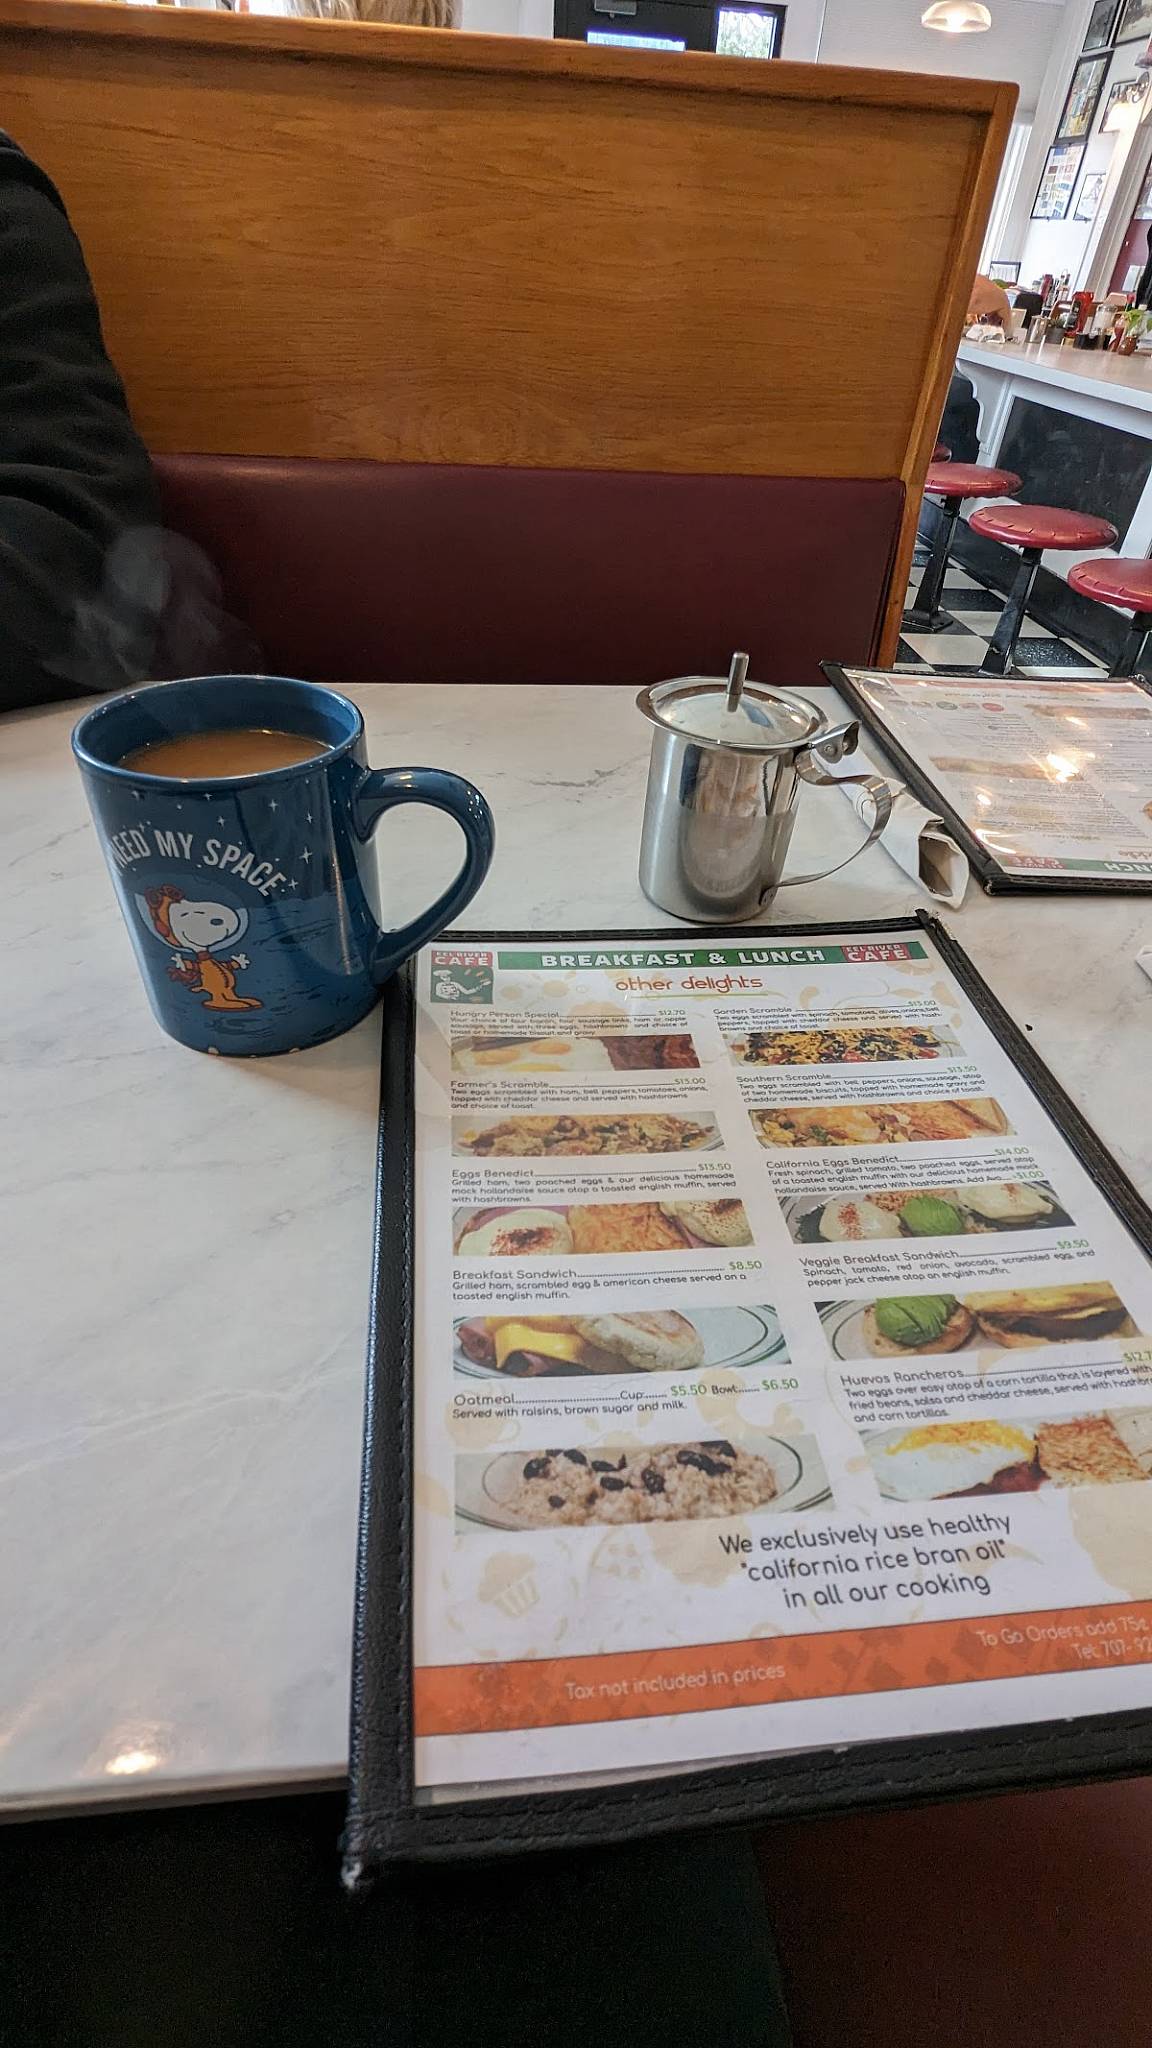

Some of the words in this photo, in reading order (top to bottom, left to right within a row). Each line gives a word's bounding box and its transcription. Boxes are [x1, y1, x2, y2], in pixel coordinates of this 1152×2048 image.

[111, 829, 151, 868] NEED
[153, 830, 193, 860] MY
[203, 839, 287, 897] SPACE
[434, 956, 489, 966] CAFE
[542, 953, 695, 967] BREAKFAST
[708, 952, 727, 964] &
[739, 950, 825, 964] LUNCH
[847, 949, 907, 961] CAFE
[616, 976, 673, 991] other
[681, 974, 764, 994] delights
[451, 1010, 487, 1018] Hungry
[525, 1011, 559, 1019] Special
[749, 1005, 792, 1013] Scramble
[451, 1080, 497, 1088] Farmer's
[501, 1079, 549, 1087] Scramble
[785, 1072, 831, 1080] Scramble
[766, 1159, 820, 1168] California
[822, 1158, 849, 1167] Eggs
[851, 1155, 899, 1164] Benedict
[768, 1169, 794, 1177] Fresh
[836, 1166, 863, 1176] grilled
[918, 1160, 956, 1171] poached
[984, 1157, 1012, 1165] served
[452, 1170, 481, 1179] Eggs
[484, 1168, 534, 1177] Benedict
[775, 1185, 827, 1194] hollandaise
[859, 1182, 886, 1190] served
[967, 1176, 984, 1184] Add
[799, 1257, 840, 1268] Veggie
[843, 1253, 899, 1264] Breakfast
[902, 1249, 959, 1261] Sandwich
[1057, 1239, 1089, 1250] $9.50
[453, 1269, 512, 1279] Breakfast
[517, 1267, 576, 1278] Sandwich
[729, 1261, 763, 1271] $8.50
[803, 1266, 845, 1278] Spinach,
[852, 1264, 889, 1273] tomato,
[896, 1262, 912, 1270] red
[1002, 1252, 1050, 1263] scrambled
[1077, 1248, 1095, 1257] and
[452, 1281, 485, 1290] Grilled
[489, 1281, 513, 1290] ham,
[517, 1279, 569, 1288] scrambled
[572, 1280, 591, 1289] egg
[603, 1277, 650, 1286] american
[653, 1275, 687, 1284] cheese
[690, 1273, 721, 1282] served
[808, 1278, 841, 1288] pepper
[844, 1275, 865, 1286] jack
[867, 1275, 900, 1283] cheese
[902, 1272, 926, 1282] atop
[942, 1269, 975, 1280] english
[453, 1291, 493, 1300] toasted
[496, 1290, 533, 1301] english
[536, 1290, 570, 1298] muffin.
[840, 1375, 890, 1385] Huevos
[895, 1369, 964, 1381] Rancheros
[844, 1388, 866, 1397] Two
[868, 1387, 893, 1397] eggs
[896, 1385, 917, 1393] over
[921, 1383, 944, 1392] easy
[946, 1379, 971, 1390] atop
[973, 1377, 985, 1387] of
[995, 1377, 1018, 1385] corn
[1021, 1371, 1055, 1383] tortilla
[1057, 1369, 1079, 1380] that
[1081, 1368, 1091, 1377] is
[1090, 1364, 1129, 1378] layered
[454, 1393, 514, 1405] Oatmeal
[620, 1387, 644, 1399] Cup
[670, 1383, 707, 1395] $5.50
[711, 1382, 737, 1393] Bowl
[762, 1379, 799, 1390] $6.50
[849, 1399, 874, 1410] fried
[877, 1398, 913, 1408] beans,
[914, 1394, 942, 1404] salsa
[944, 1390, 965, 1401] and
[966, 1387, 1010, 1399] cheddar
[1013, 1385, 1052, 1395] cheese,
[1054, 1379, 1088, 1391] served
[1090, 1377, 1112, 1388] with
[453, 1407, 492, 1418] Served
[495, 1406, 518, 1416] with
[522, 1405, 562, 1415] raisins,
[564, 1404, 599, 1413] brown
[602, 1404, 634, 1413] sugar
[637, 1400, 659, 1410] and
[662, 1399, 687, 1409] milk.
[854, 1411, 876, 1422] and
[878, 1412, 903, 1420] corn
[719, 1536, 752, 1554] We
[760, 1525, 877, 1551] exclusively
[884, 1525, 924, 1540] use
[928, 1514, 1010, 1536] healthy
[741, 1555, 859, 1581] "california
[865, 1551, 909, 1570] rice
[913, 1548, 970, 1566] bran
[976, 1541, 1005, 1560] oil"
[784, 1589, 807, 1607] in
[814, 1585, 843, 1605] all
[849, 1588, 887, 1602] our
[896, 1576, 991, 1599] cooking
[976, 1631, 998, 1646] To
[1000, 1629, 1023, 1644] Go
[1026, 1625, 1083, 1641] Orders
[1086, 1619, 1118, 1636] add
[566, 1683, 593, 1698] Tax
[599, 1678, 629, 1695] not
[633, 1671, 708, 1692] included
[711, 1670, 729, 1685] in
[733, 1666, 786, 1688] prices
